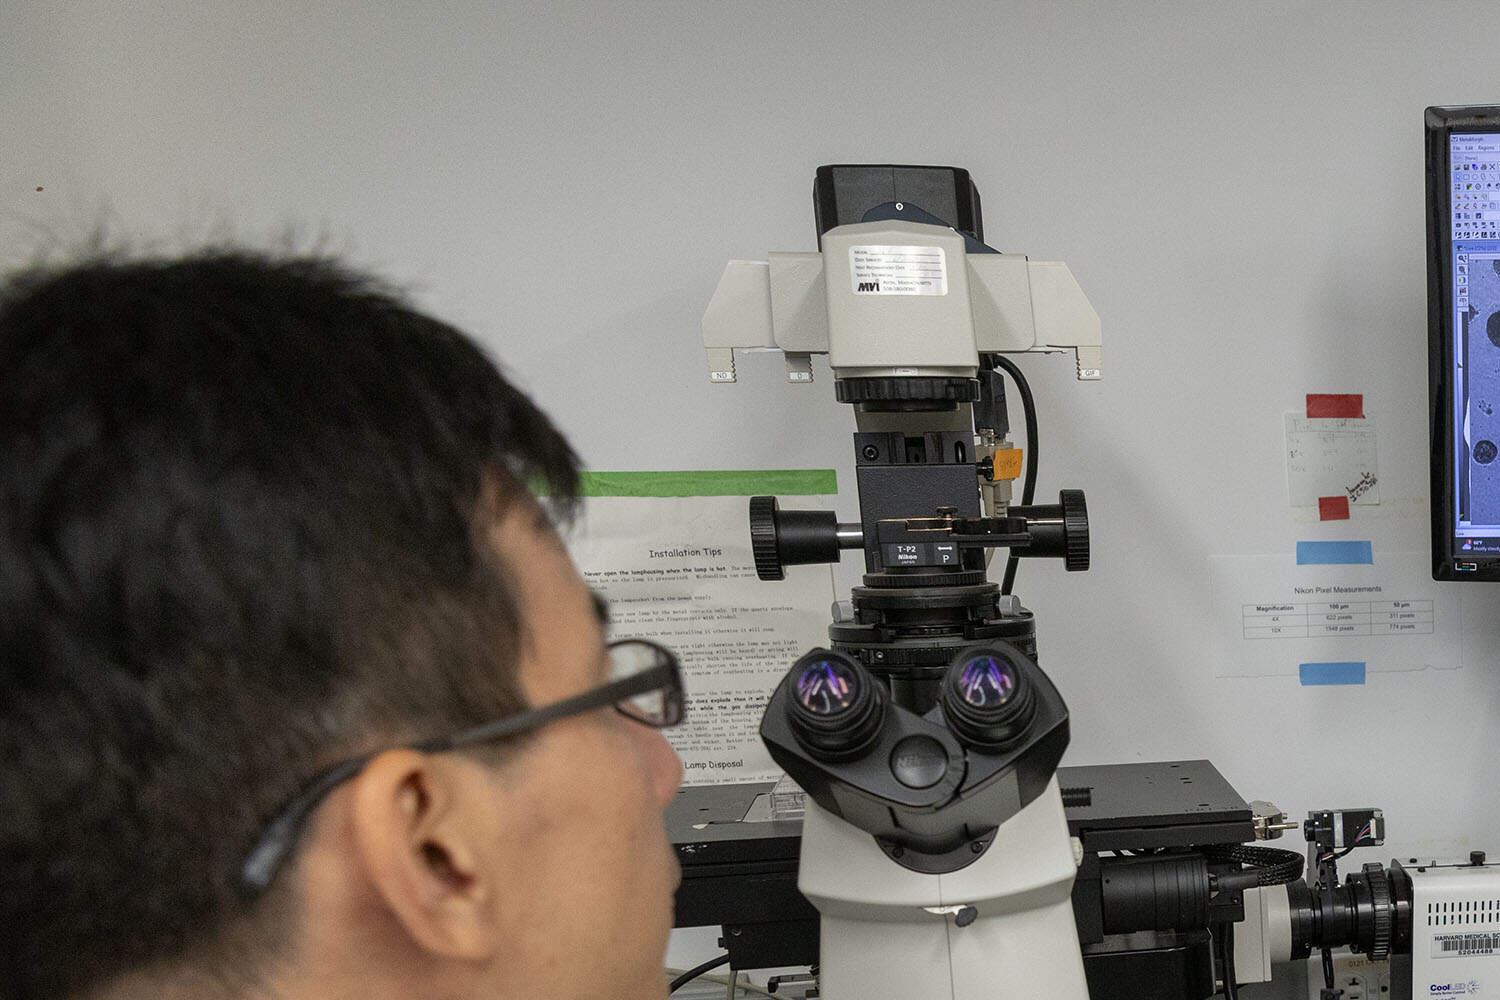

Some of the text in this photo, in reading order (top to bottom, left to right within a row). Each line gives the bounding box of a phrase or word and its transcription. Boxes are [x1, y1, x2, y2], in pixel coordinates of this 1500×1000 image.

[649, 548, 722, 559] Installation Tips
[943, 554, 950, 563] P
[1294, 585, 1382, 594] Nikon Pixel Measurements
[1256, 604, 1294, 612] Magnification
[685, 760, 744, 770] Lamp Disposal
